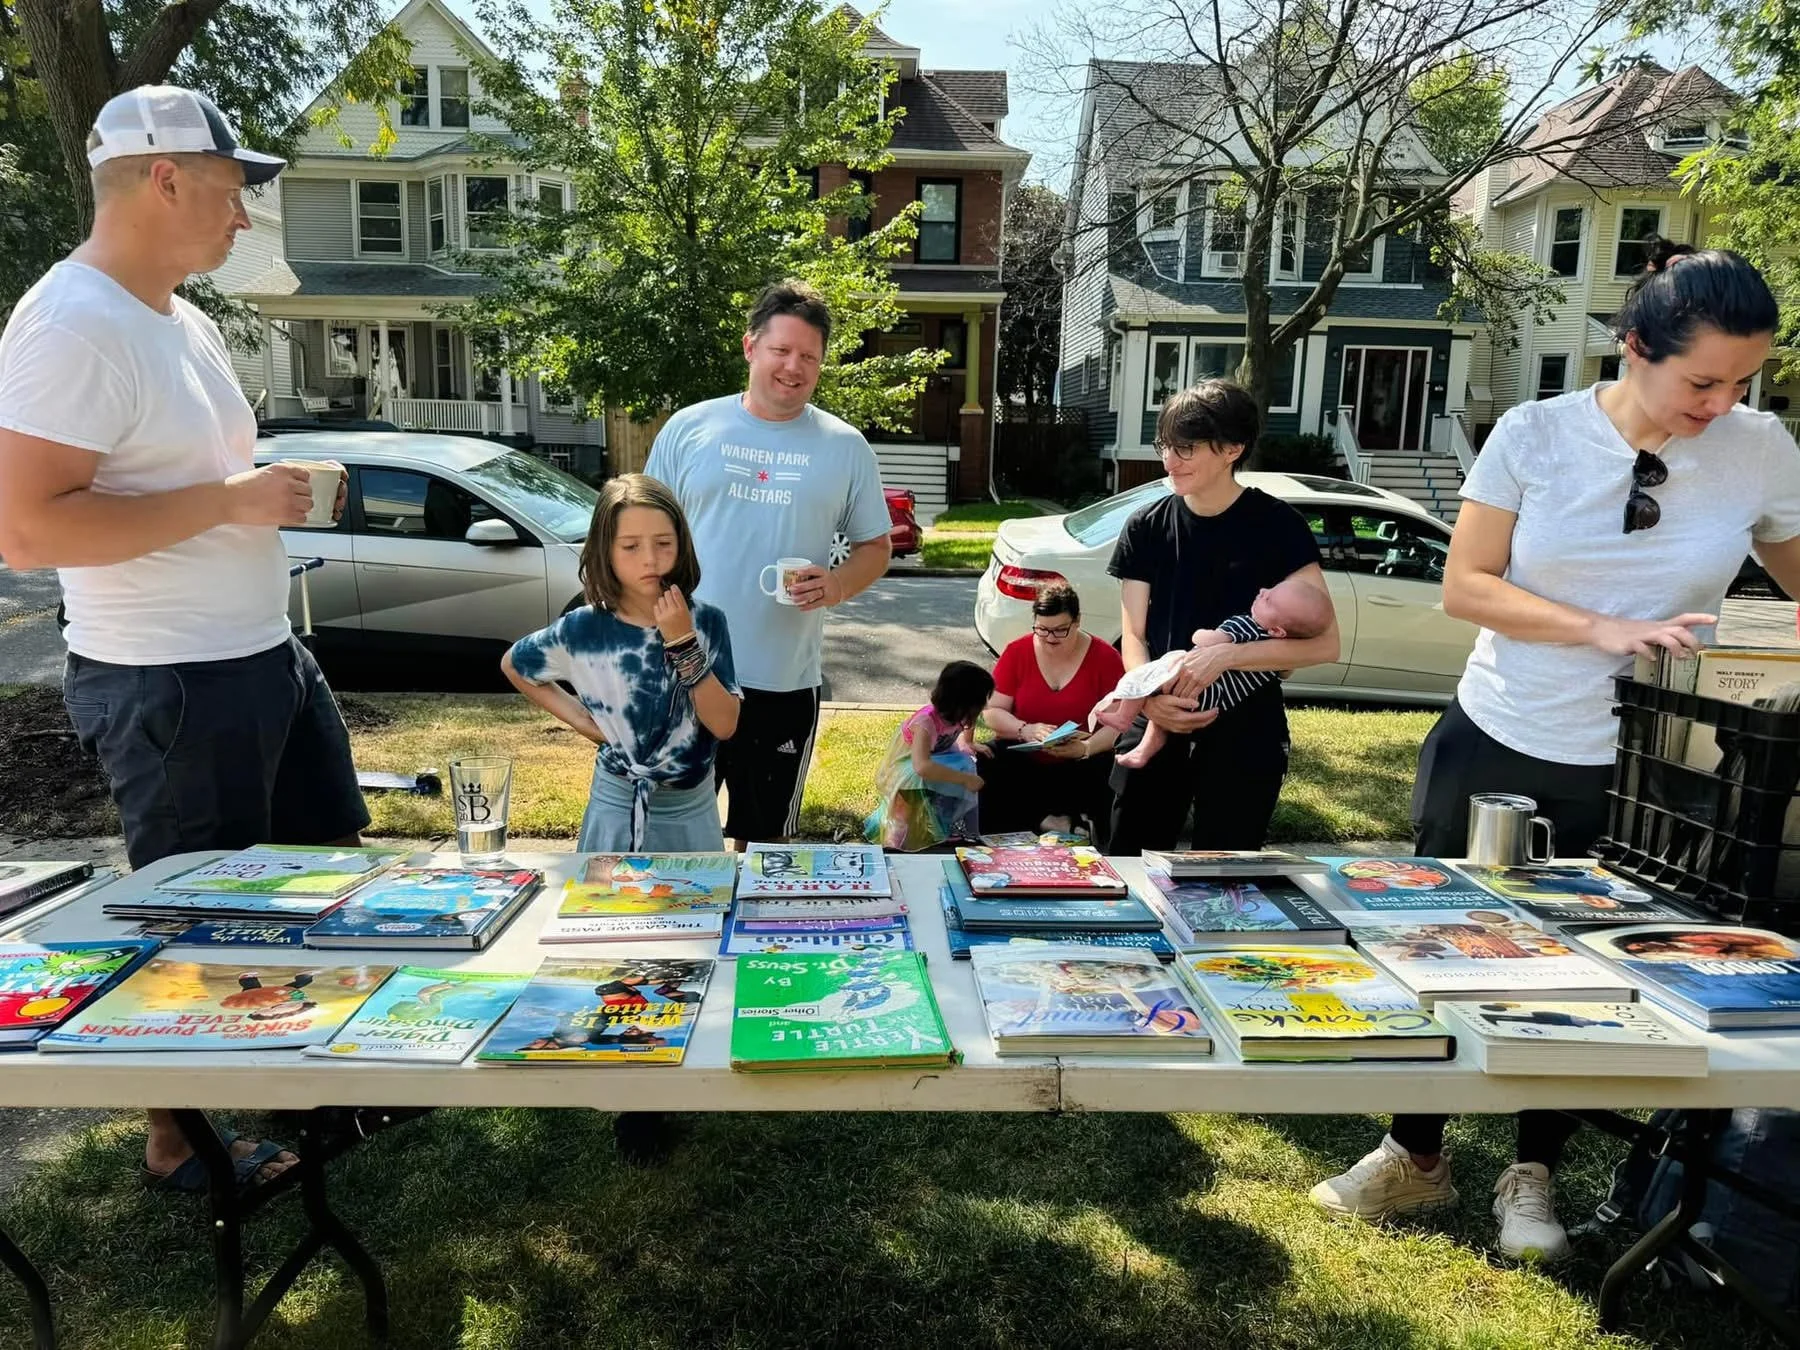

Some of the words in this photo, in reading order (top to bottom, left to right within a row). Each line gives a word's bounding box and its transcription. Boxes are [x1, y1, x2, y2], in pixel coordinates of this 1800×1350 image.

[720, 443, 774, 465] WARREN
[776, 450, 810, 467] PARK
[727, 481, 792, 505] ALLSTARS
[1717, 677, 1760, 690] STORY
[1730, 690, 1744, 701] of
[1283, 895, 1332, 925] PLENTY
[746, 960, 809, 974] Seuss
[812, 958, 850, 975] Dr.
[764, 976, 793, 987] By
[572, 1002, 688, 1017] Matter?
[783, 1008, 816, 1016] Other
[1225, 1003, 1305, 1012] BOOK
[175, 1014, 245, 1025] EVER
[200, 1019, 313, 1034] SUKKOT
[358, 1017, 479, 1031] Dinosaur
[569, 1016, 599, 1029] Is
[605, 1014, 683, 1027] What
[768, 1020, 791, 1028] and
[1232, 1013, 1432, 1031] Cranks
[77, 1023, 198, 1037] PUMPKIN
[355, 1028, 451, 1044] Digger
[771, 1019, 888, 1041] TURTLE
[814, 1025, 944, 1052] YERTLE
